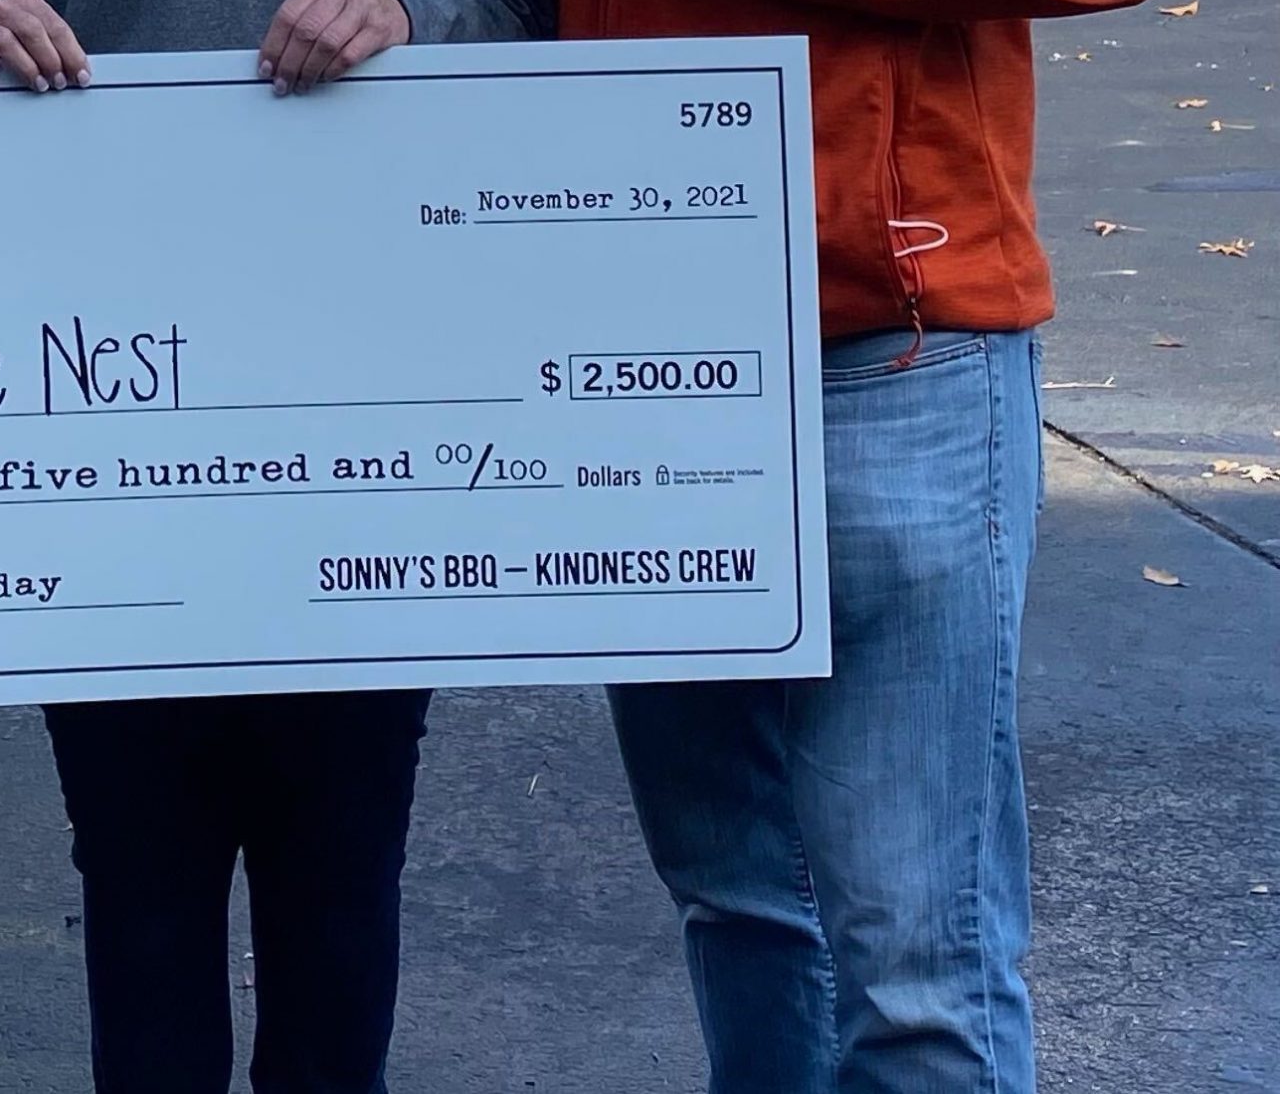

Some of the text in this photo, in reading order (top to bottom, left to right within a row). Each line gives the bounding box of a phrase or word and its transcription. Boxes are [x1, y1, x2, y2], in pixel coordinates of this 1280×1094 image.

[680, 101, 752, 128] 5789
[421, 184, 748, 226] Date: November 30, 2021
[42, 316, 188, 415] Nest
[540, 359, 738, 397] $ 2,500.00
[117, 453, 311, 488] hundred
[333, 451, 414, 480] and
[578, 465, 641, 488] Dollars
[319, 555, 436, 593] SONNY'S
[444, 554, 498, 589] BBQ
[535, 549, 670, 586] KINDNESS
[679, 548, 758, 583] CREW
